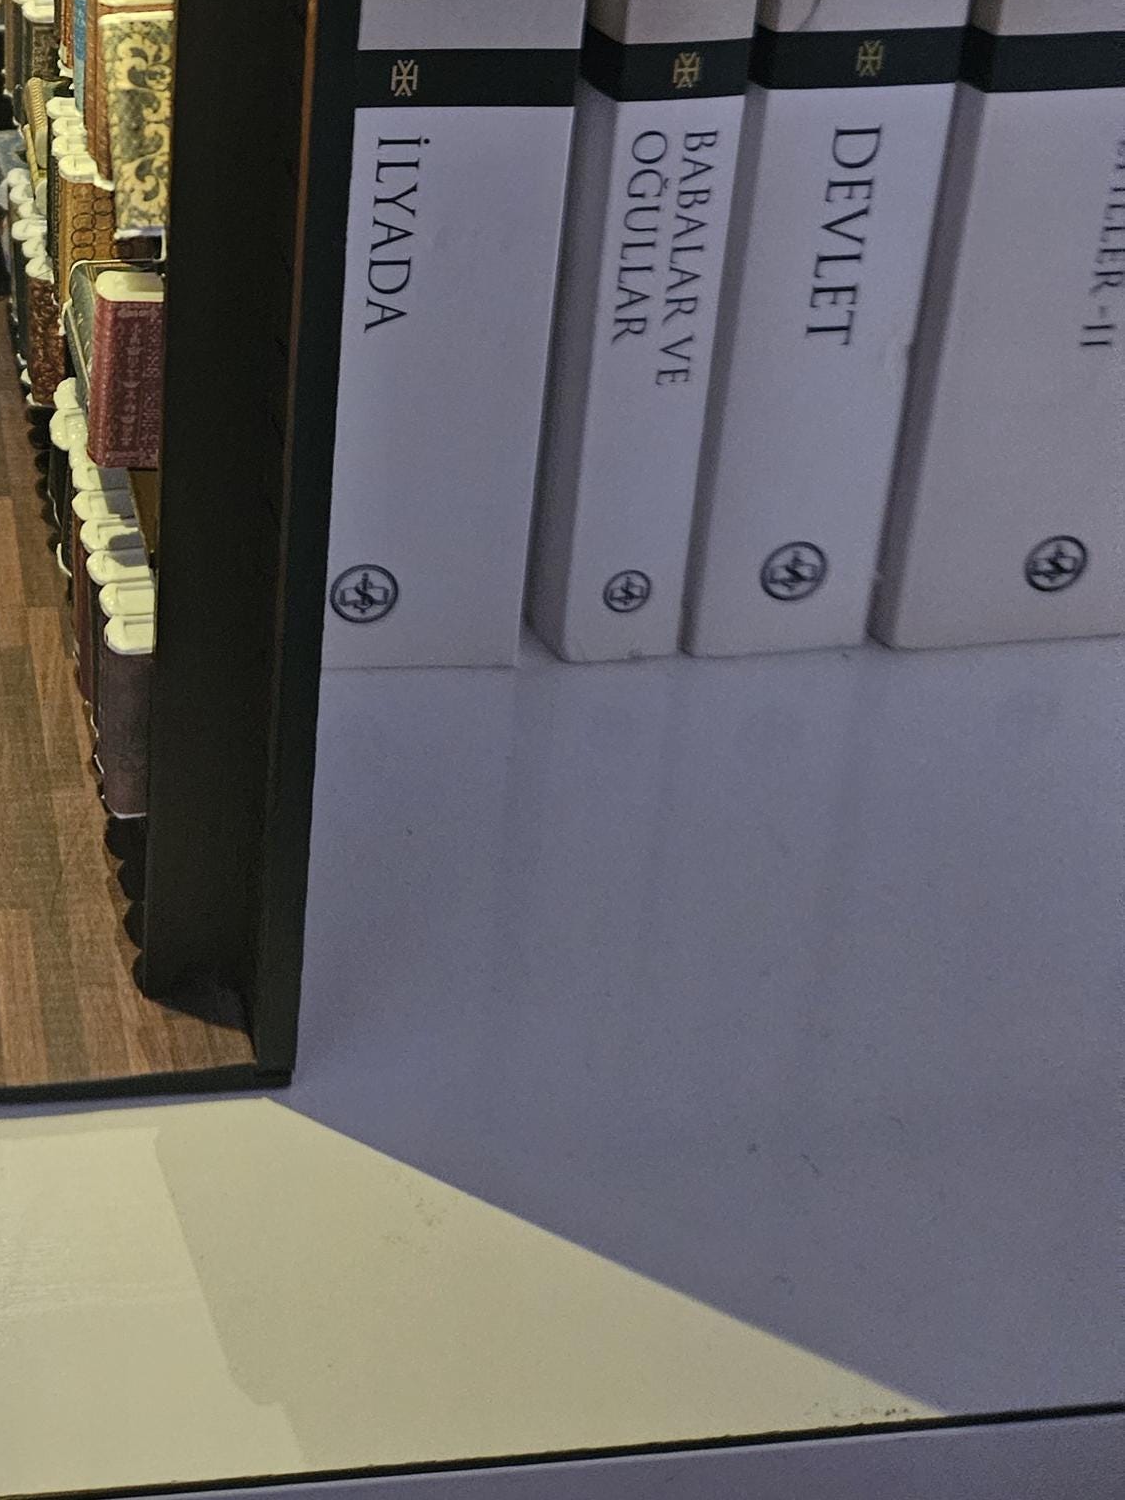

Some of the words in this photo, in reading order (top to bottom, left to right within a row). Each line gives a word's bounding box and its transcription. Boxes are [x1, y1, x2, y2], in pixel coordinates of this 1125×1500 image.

[364, 137, 431, 333] İLYADA
[611, 129, 670, 344] OĞULLAR
[661, 129, 720, 325] BABALAR
[806, 126, 882, 346] DEVLET
[655, 335, 694, 386] VE
